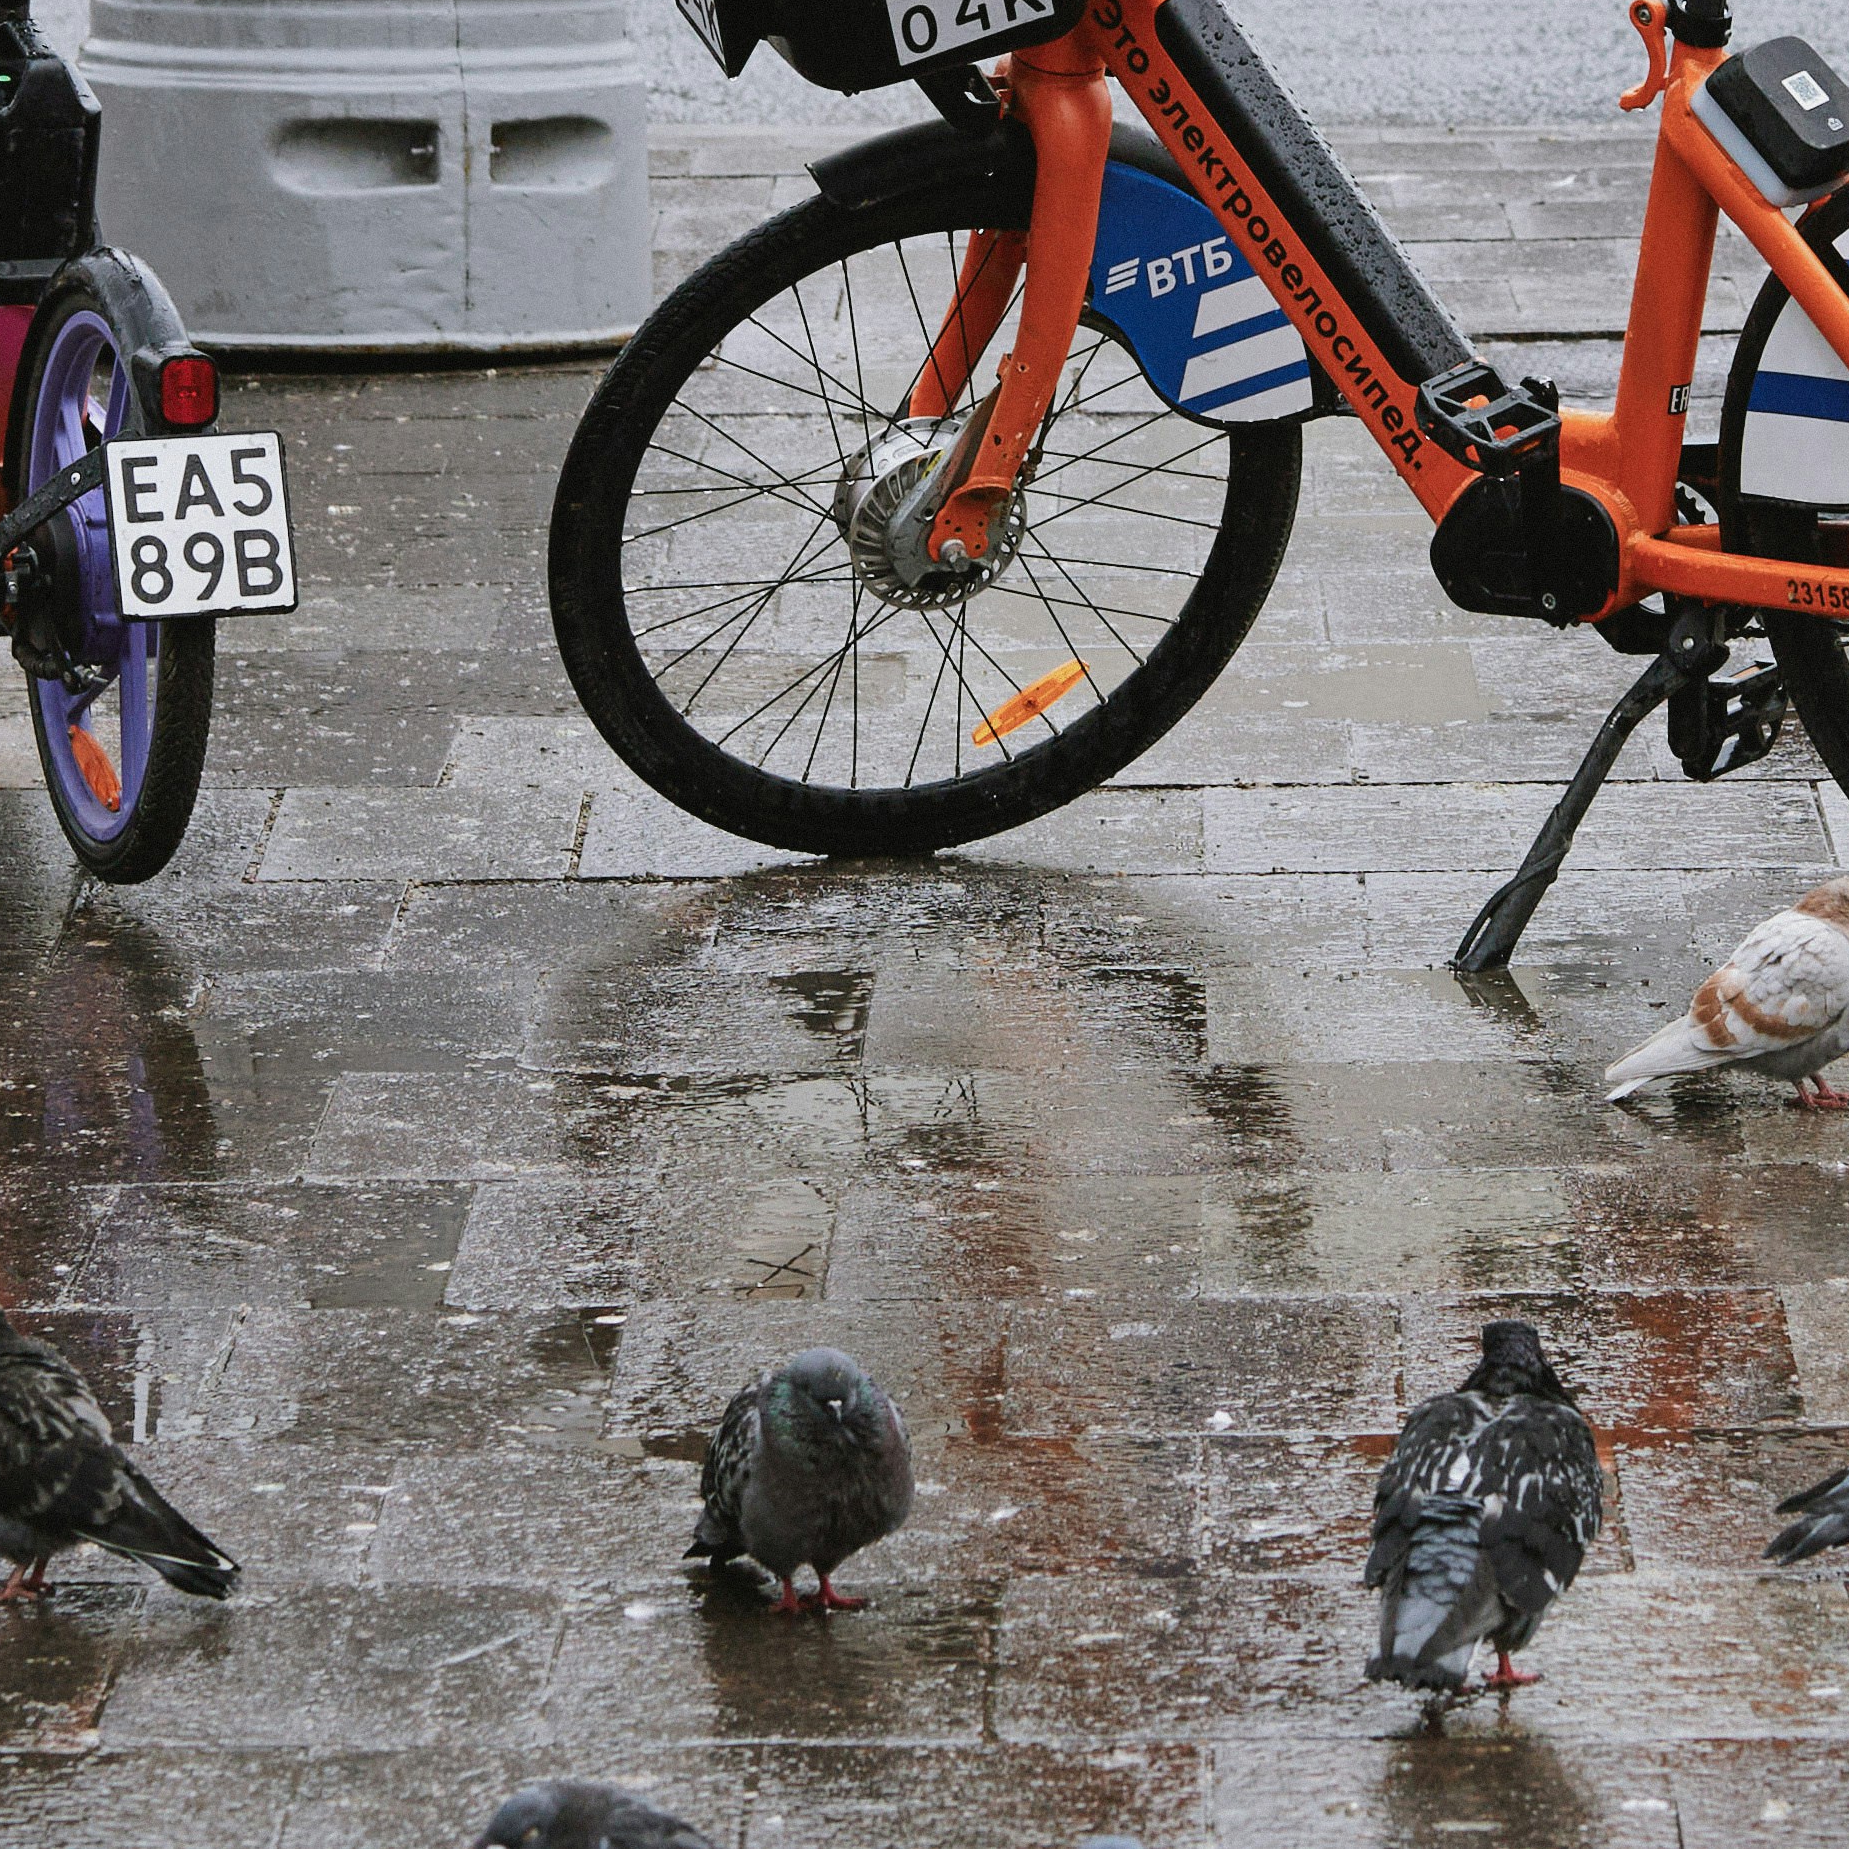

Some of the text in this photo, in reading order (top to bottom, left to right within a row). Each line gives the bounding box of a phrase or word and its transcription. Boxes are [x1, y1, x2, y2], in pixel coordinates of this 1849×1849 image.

[1146, 235, 1234, 299] ВТБ
[1147, 76, 1424, 472] электровелосипед.
[120, 447, 273, 524] EA5
[130, 528, 284, 605] 89B
